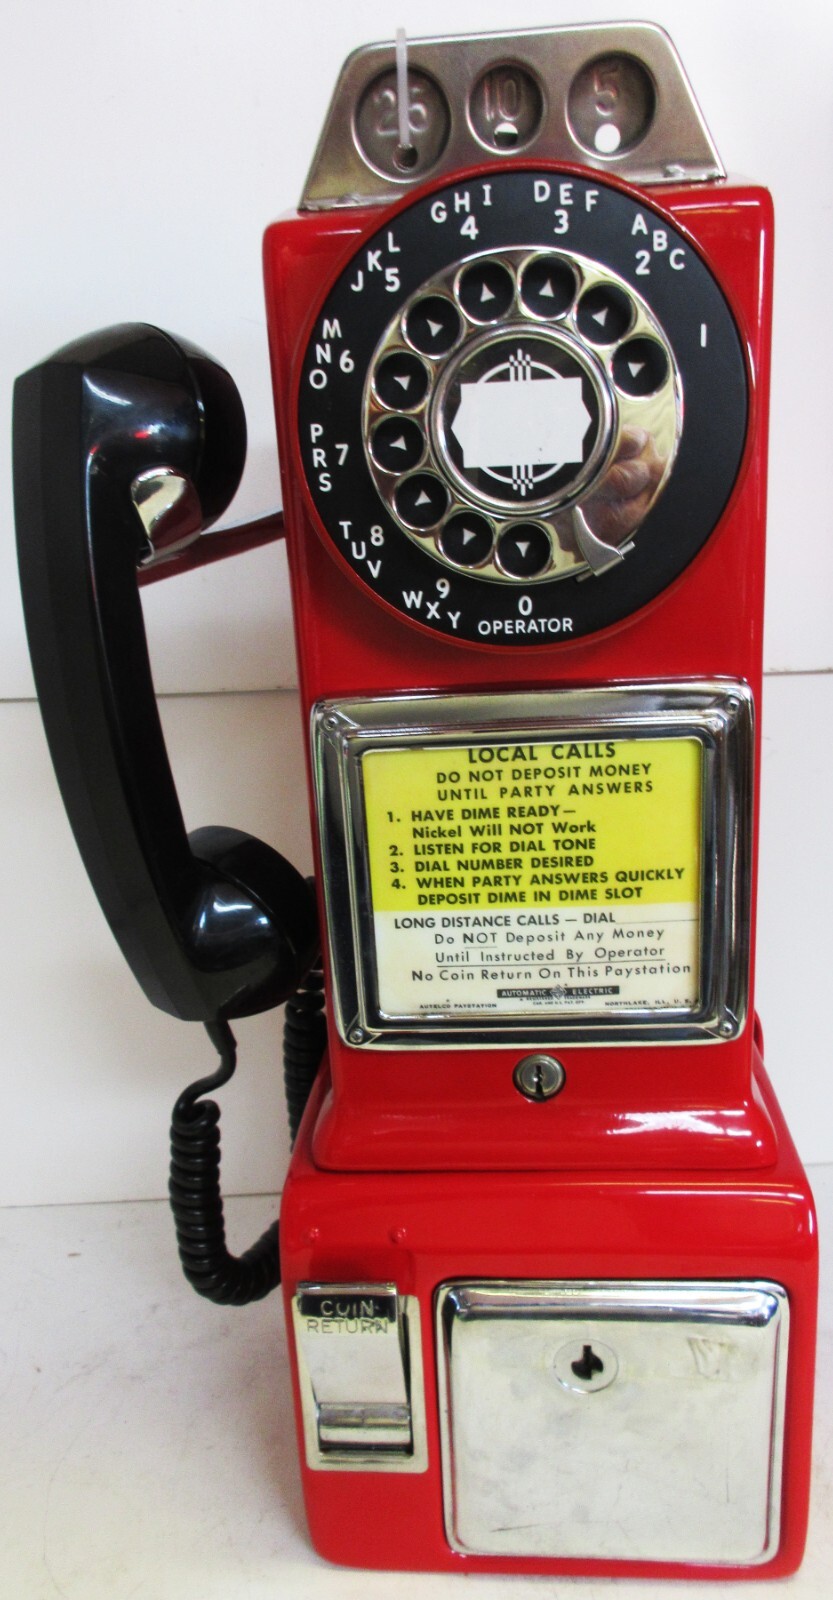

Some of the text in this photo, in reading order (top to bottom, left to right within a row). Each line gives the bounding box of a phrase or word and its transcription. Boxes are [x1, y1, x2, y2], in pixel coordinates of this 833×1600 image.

[483, 75, 522, 121] 10
[594, 66, 619, 117] 5
[460, 215, 479, 240] 4
[554, 209, 570, 235] 3
[635, 250, 651, 276] 2
[384, 267, 401, 293] 5
[338, 349, 355, 374] 6
[335, 443, 349, 466] 7
[369, 525, 385, 547] 8
[436, 578, 451, 600] 9
[477, 617, 574, 635] OPERATOR
[468, 741, 616, 763] LOCAL CALLS
[437, 763, 652, 784] DO NOT DEPOSIT MONEY
[437, 781, 654, 801] UNTIL PARTY ANSWERS
[386, 811, 401, 823] 1.
[411, 809, 454, 822] HAVE
[461, 807, 500, 820] DIME
[412, 820, 596, 839] Nickel Will NOT Work
[389, 838, 596, 857] 2. LISTEN FOR DIAL TONE
[390, 855, 594, 873] 3. DIAL NUMBER DESIRED
[391, 867, 685, 889] 4. WHEN PARTY ANSWERS QUICKLY
[418, 886, 643, 905] DEPOSIT DIME IN DIME SLOT
[394, 917, 436, 929] LONG
[441, 915, 511, 928] DISTANCE
[516, 914, 560, 926] CALLS
[583, 912, 616, 924] DIAL
[434, 927, 665, 946] Do NOT Deposit Any Money
[435, 946, 665, 963] Until Instructed By Operator
[412, 963, 692, 982] No Coin Return On This Paystation
[501, 987, 613, 997] AUTOMATIC ELECTRIC
[320, 1299, 375, 1317] COIN
[306, 1317, 389, 1334] RETURN
